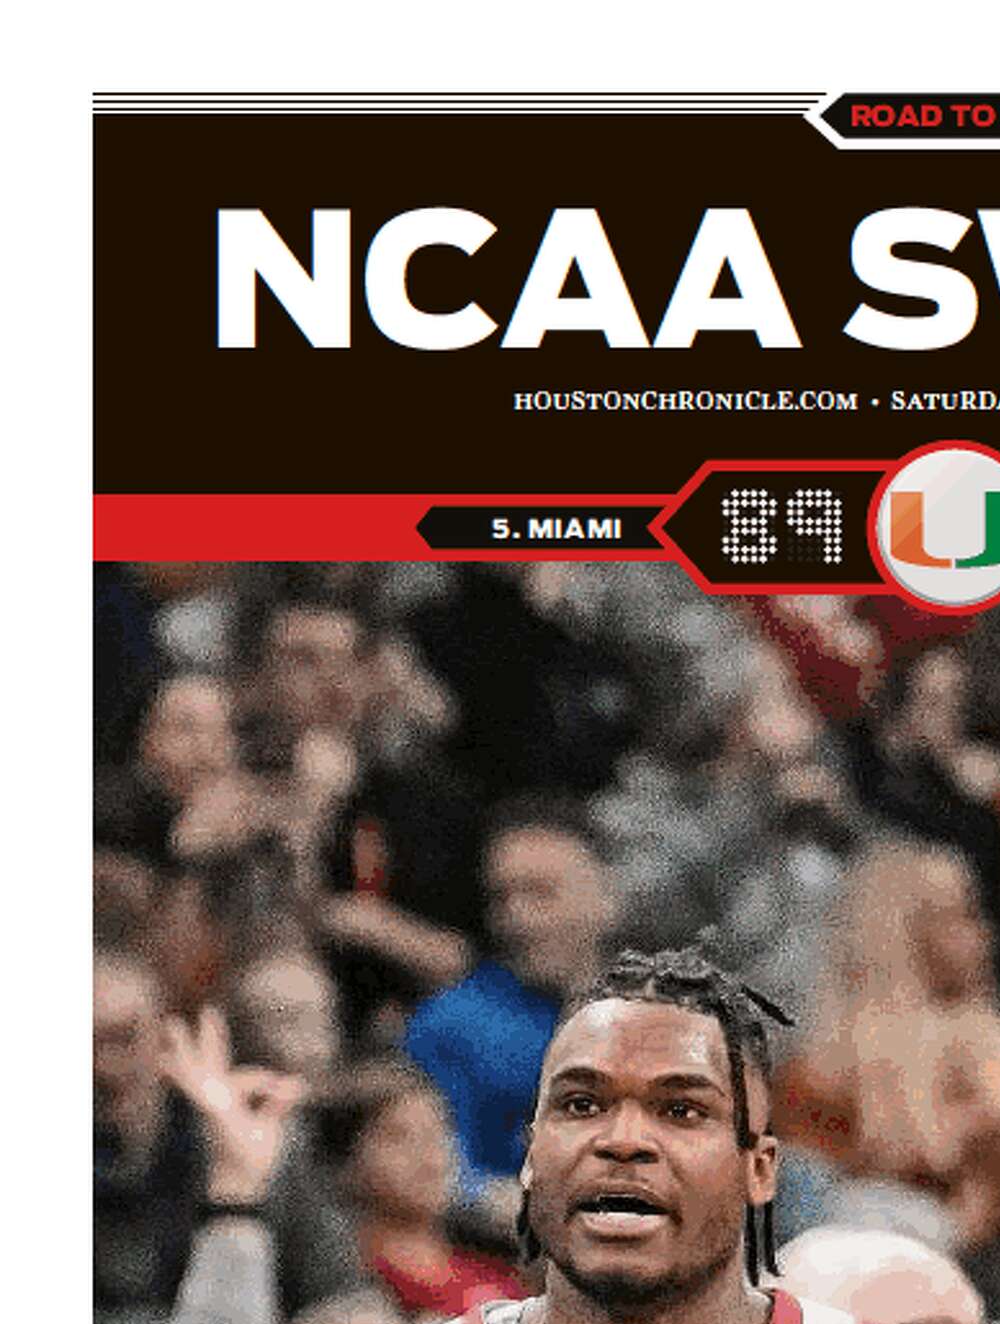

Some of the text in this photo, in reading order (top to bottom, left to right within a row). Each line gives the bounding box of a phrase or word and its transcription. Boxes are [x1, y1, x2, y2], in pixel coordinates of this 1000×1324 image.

[852, 105, 942, 127] ROAD
[951, 105, 995, 127] TO
[218, 207, 803, 350] NCAA
[514, 391, 858, 412] HOUSTONCHRONICLE.COM
[493, 518, 621, 538] 5. MIAMI
[722, 489, 842, 563] 89
